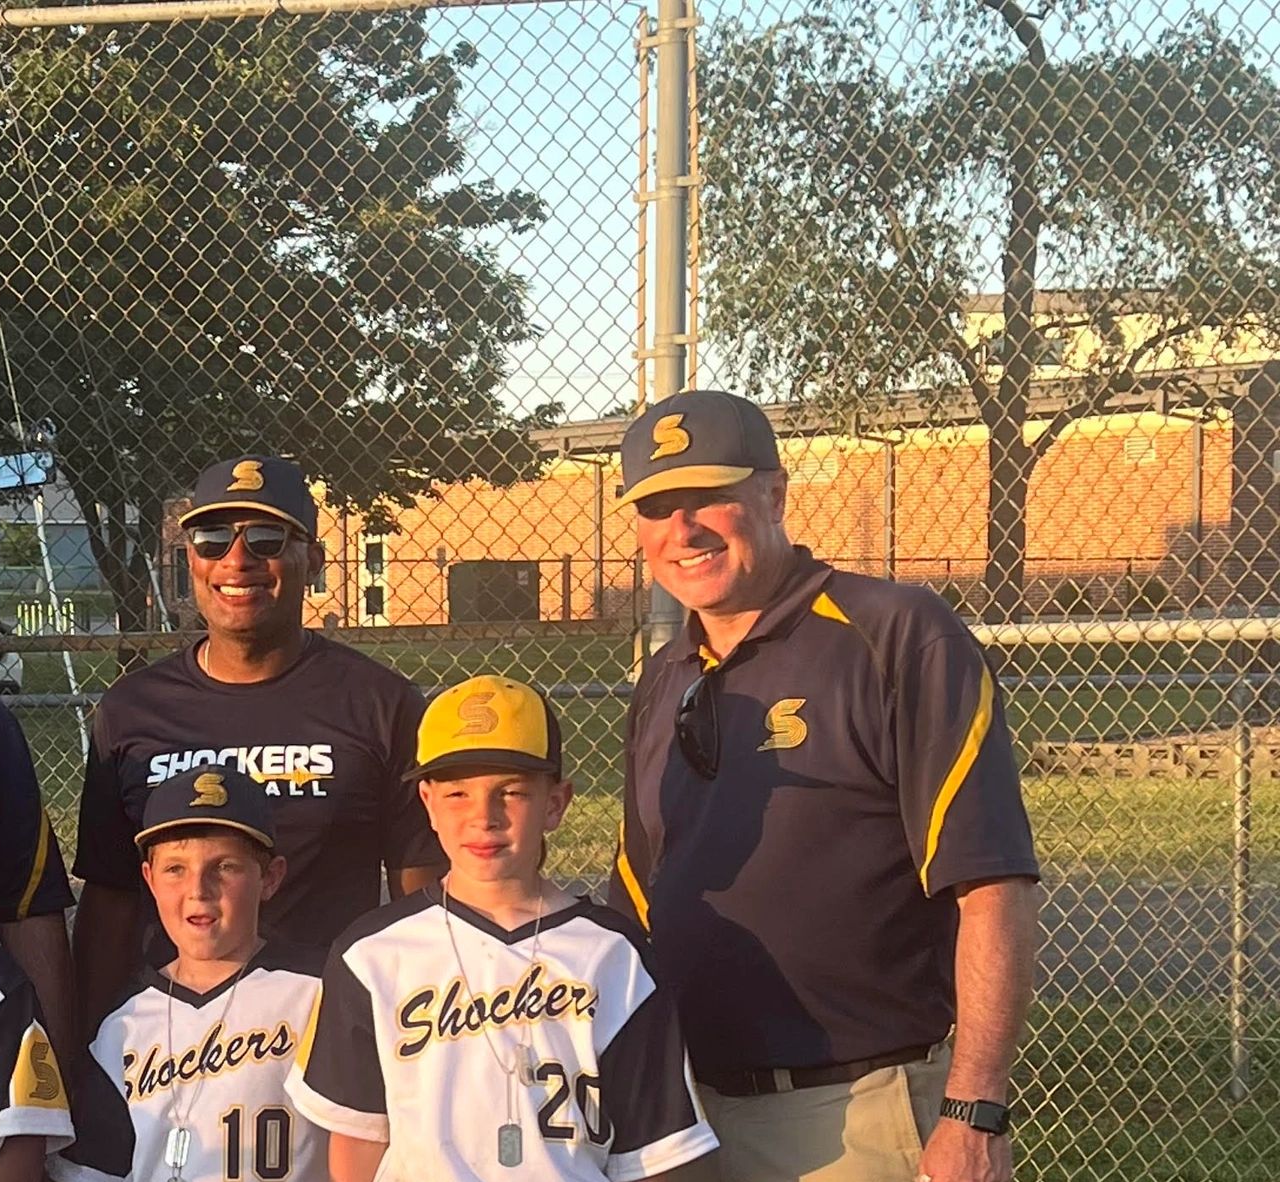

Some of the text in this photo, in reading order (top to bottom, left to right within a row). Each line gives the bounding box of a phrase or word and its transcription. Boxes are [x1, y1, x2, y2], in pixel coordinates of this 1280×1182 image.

[397, 964, 599, 1058] Shocker
[221, 1105, 293, 1182] 10
[533, 1060, 616, 1146] 20
